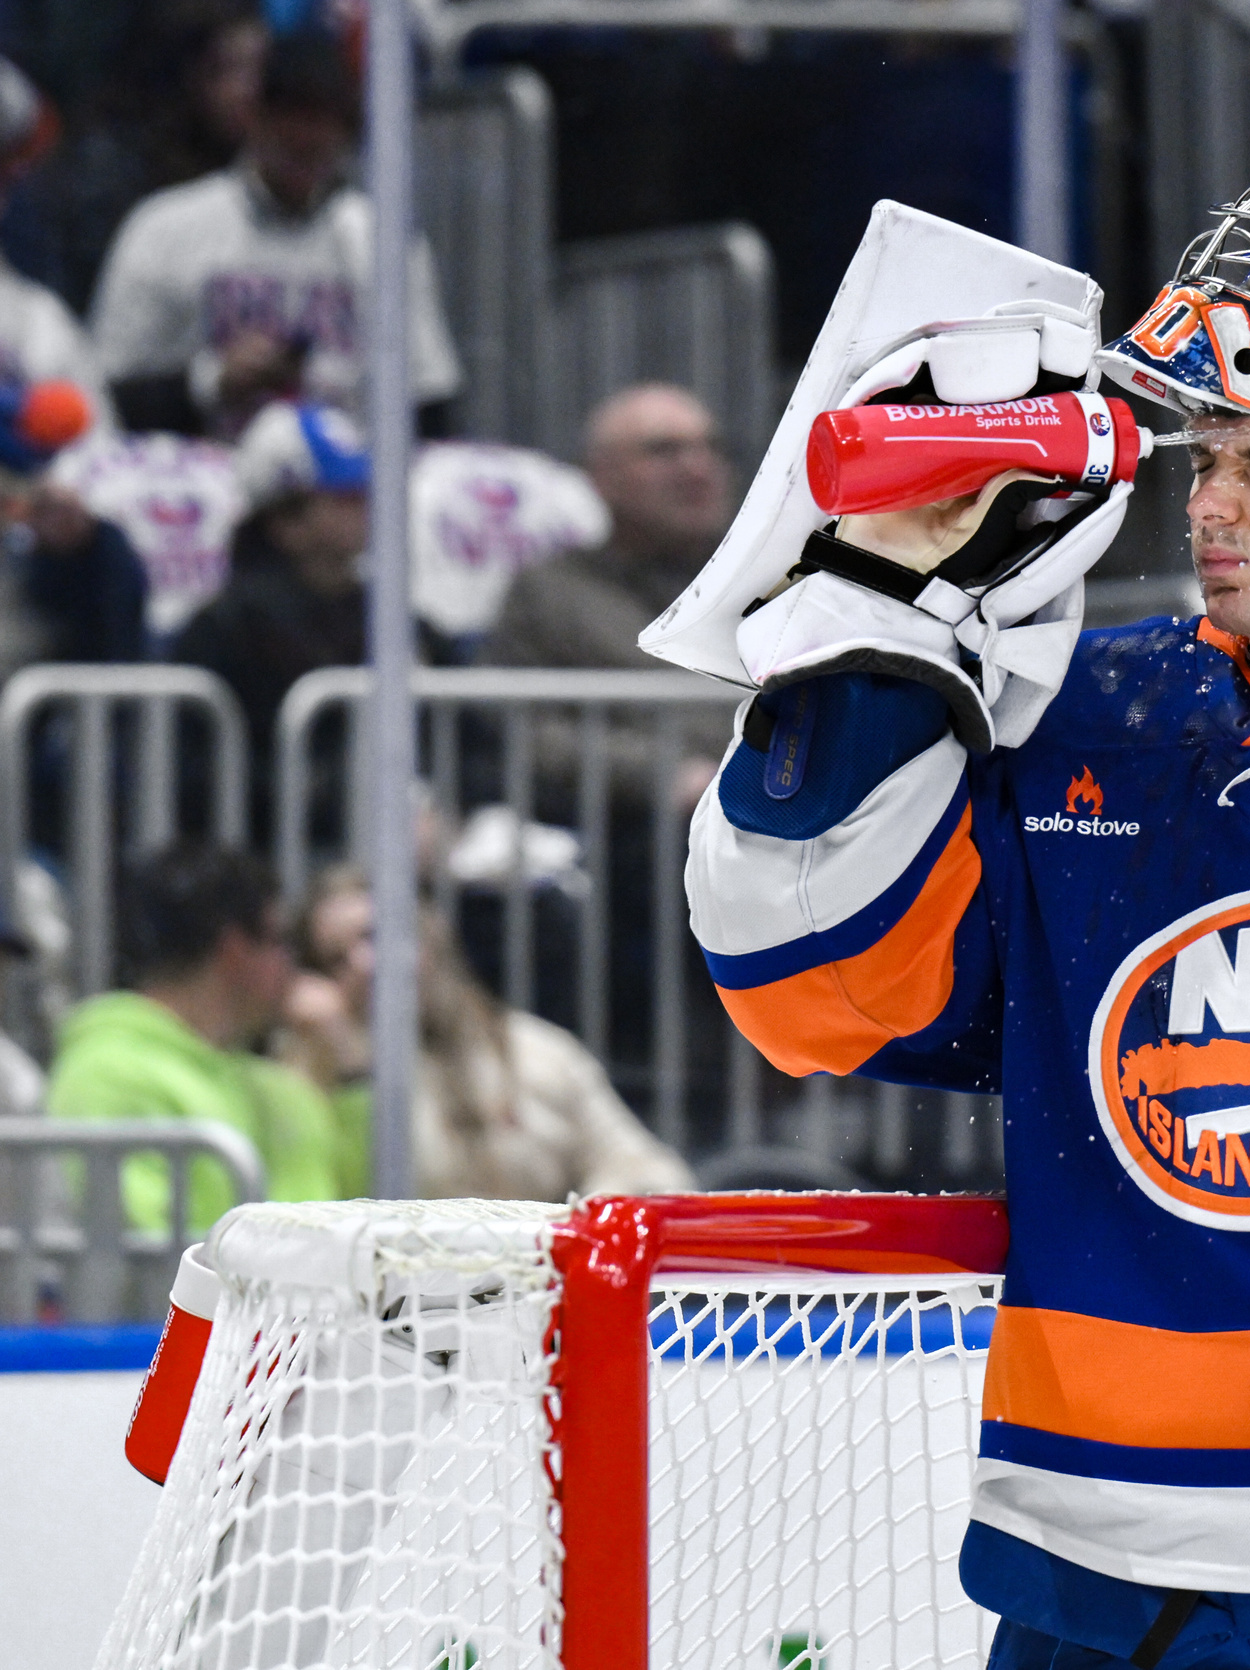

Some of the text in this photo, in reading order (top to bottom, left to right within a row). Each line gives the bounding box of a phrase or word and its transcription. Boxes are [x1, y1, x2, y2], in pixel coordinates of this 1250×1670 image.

[976, 414, 1062, 430] Sports Drink
[781, 733, 799, 787] SPEC
[1024, 812, 1140, 836] solo stove
